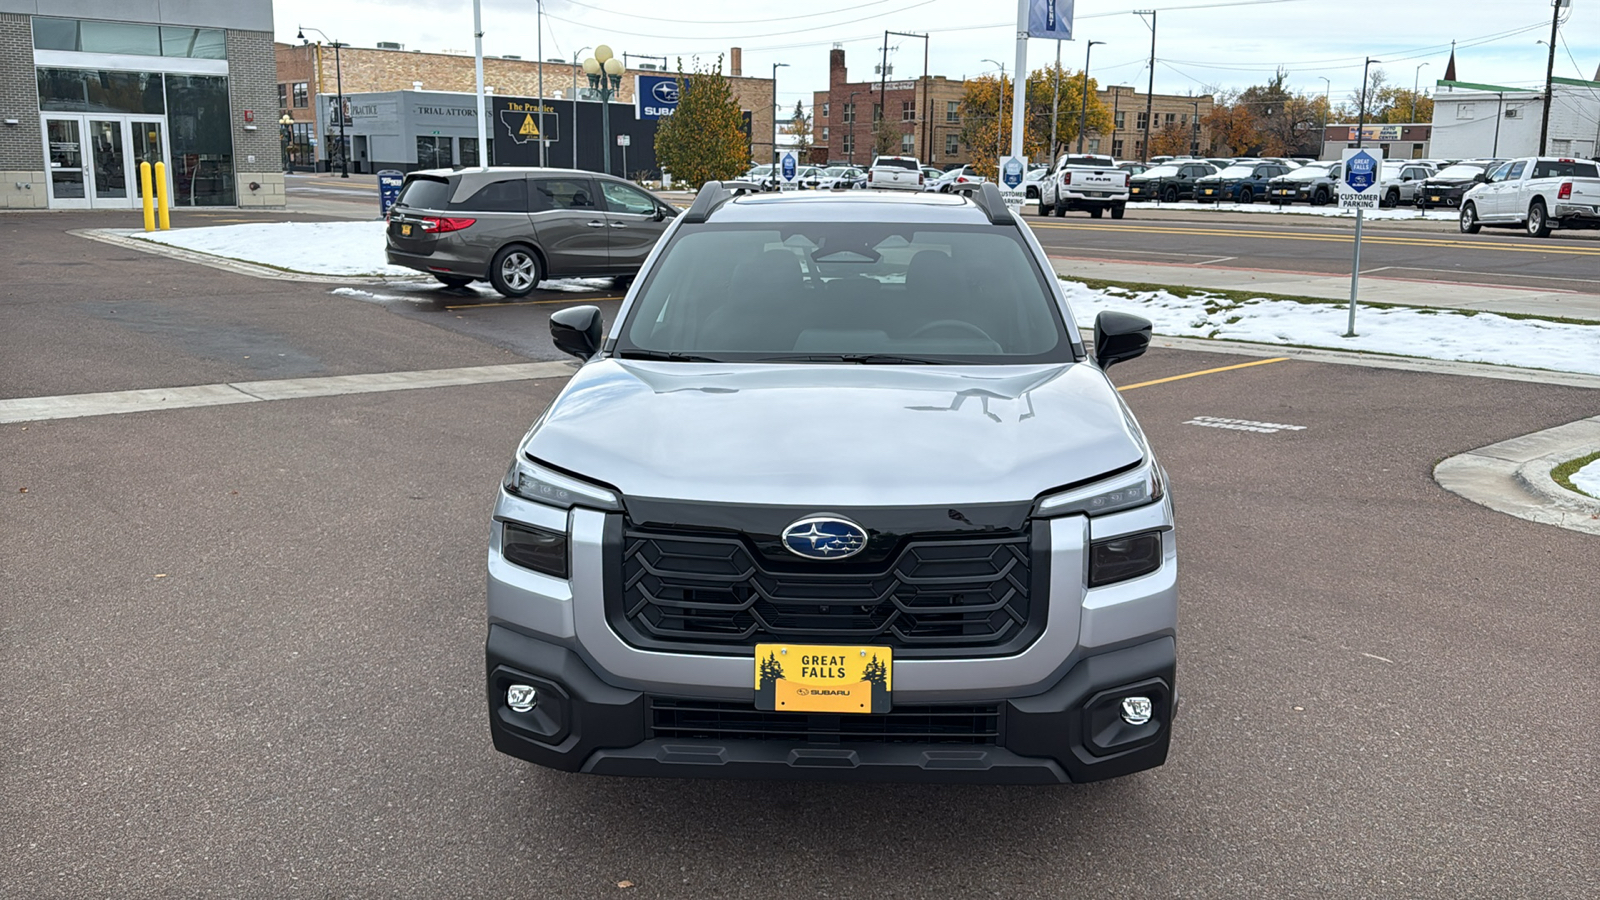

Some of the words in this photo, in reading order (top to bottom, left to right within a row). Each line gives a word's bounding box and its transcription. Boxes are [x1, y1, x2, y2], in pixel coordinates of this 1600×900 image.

[352, 105, 378, 116] PRACTICE
[418, 106, 445, 116] TRIAL
[507, 102, 523, 111] The
[644, 106, 676, 116] SUBA
[1340, 193, 1378, 201] CUSTOMER
[1343, 200, 1374, 208] PARKING
[801, 655, 846, 666] GREAT
[801, 667, 846, 678] FALLS
